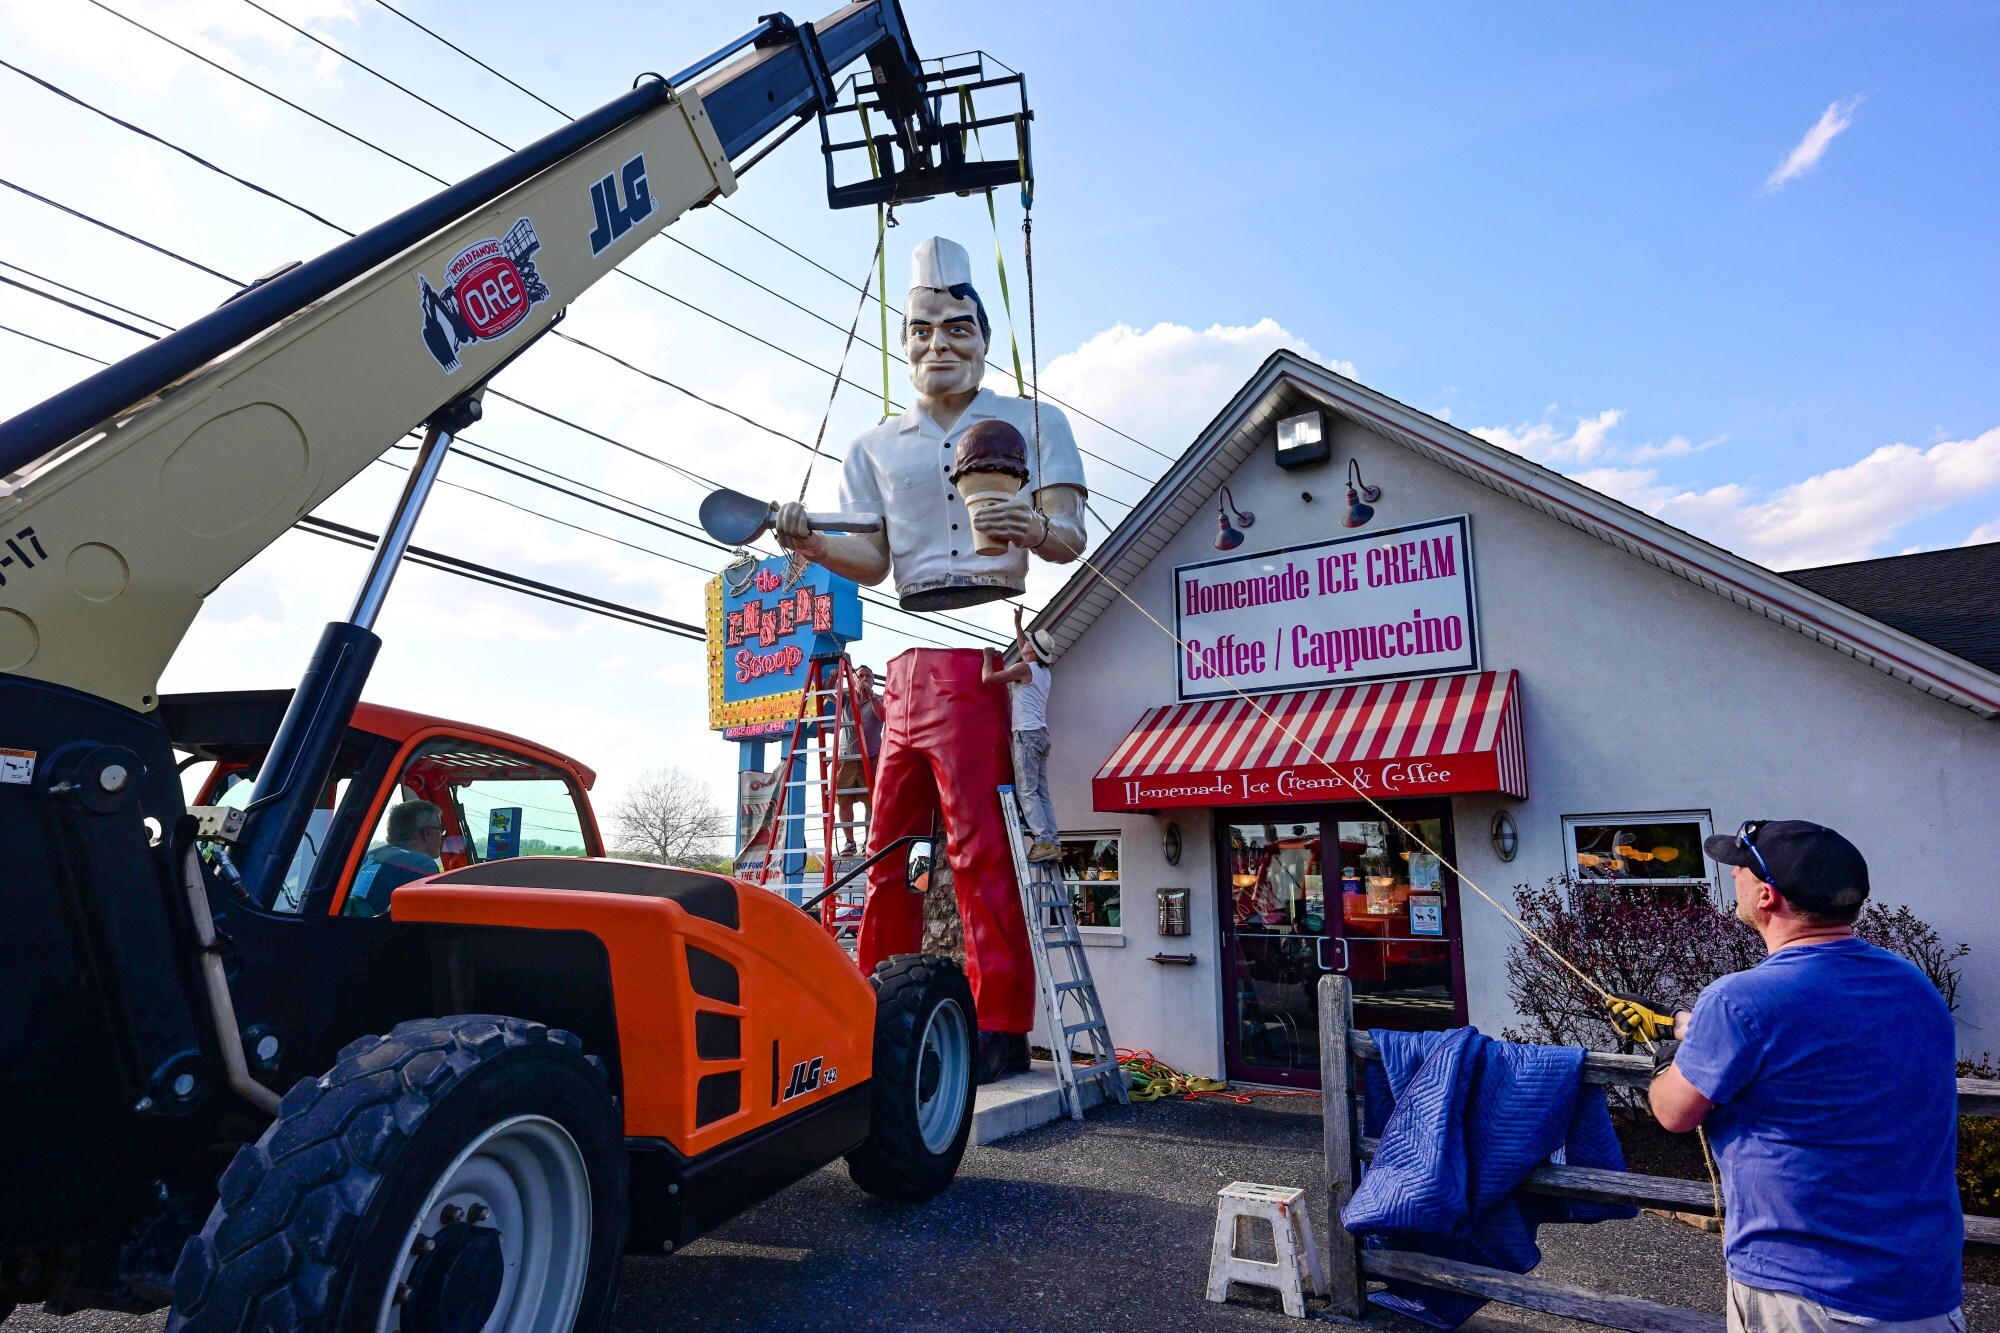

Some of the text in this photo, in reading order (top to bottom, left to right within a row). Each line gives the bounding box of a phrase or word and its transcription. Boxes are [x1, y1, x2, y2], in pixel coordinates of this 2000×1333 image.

[589, 152, 654, 259] JLG
[450, 241, 500, 276] WORLD FAMOUS
[467, 261, 494, 279] OUTSTANDING
[488, 310, 522, 334] RENTAL EXPERIENCE
[754, 568, 782, 592] the
[1185, 535, 1456, 616] Homemade ICE CREAM
[1185, 634, 1266, 681] Coffee
[1292, 608, 1463, 674] Cappuccino
[735, 645, 803, 684] Scoop
[0, 749, 24, 757] ARNING
[1123, 762, 1451, 805] Homemade Ice Cream & Coffee
[783, 1056, 837, 1102] JLG 742
